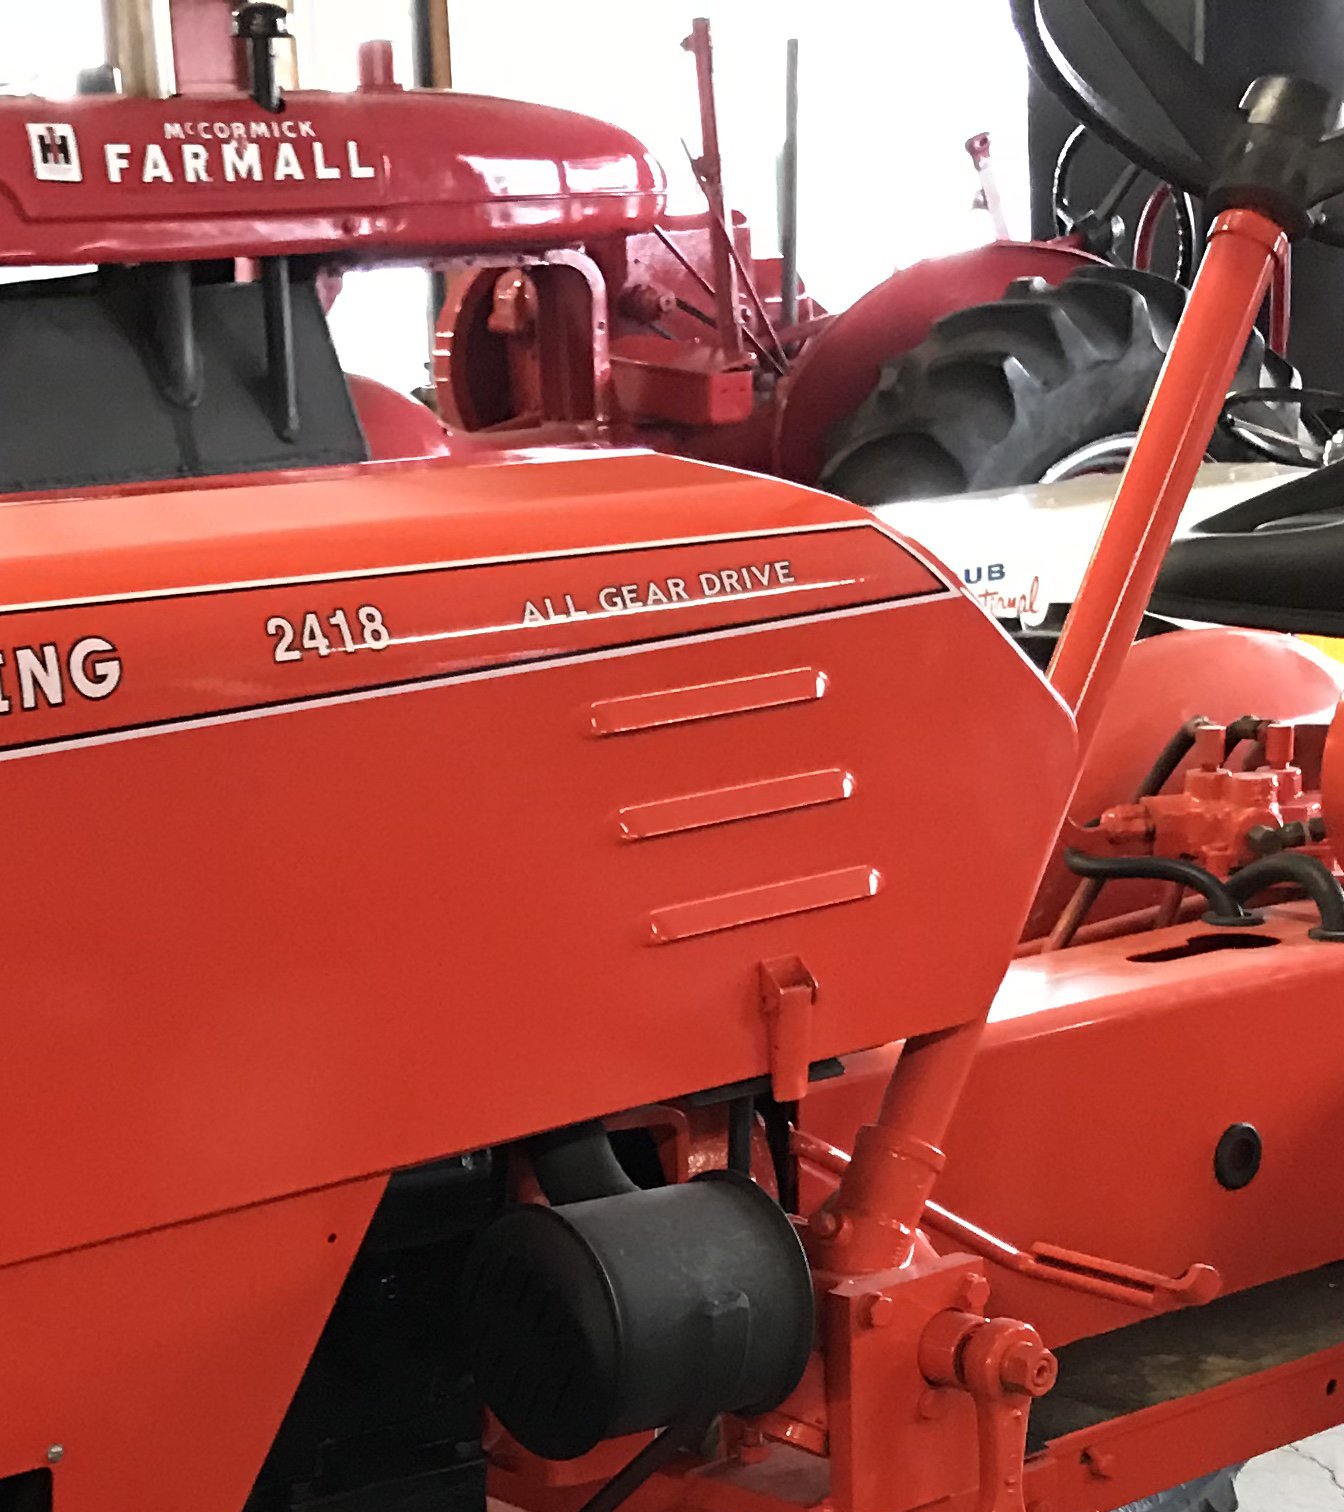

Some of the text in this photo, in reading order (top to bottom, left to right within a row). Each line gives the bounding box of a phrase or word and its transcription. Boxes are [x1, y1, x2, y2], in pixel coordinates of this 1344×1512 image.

[104, 140, 376, 183] FARMALL
[521, 560, 795, 627] ALL GEAR DRIVE
[964, 563, 1006, 584] UB
[266, 604, 390, 663] 2418
